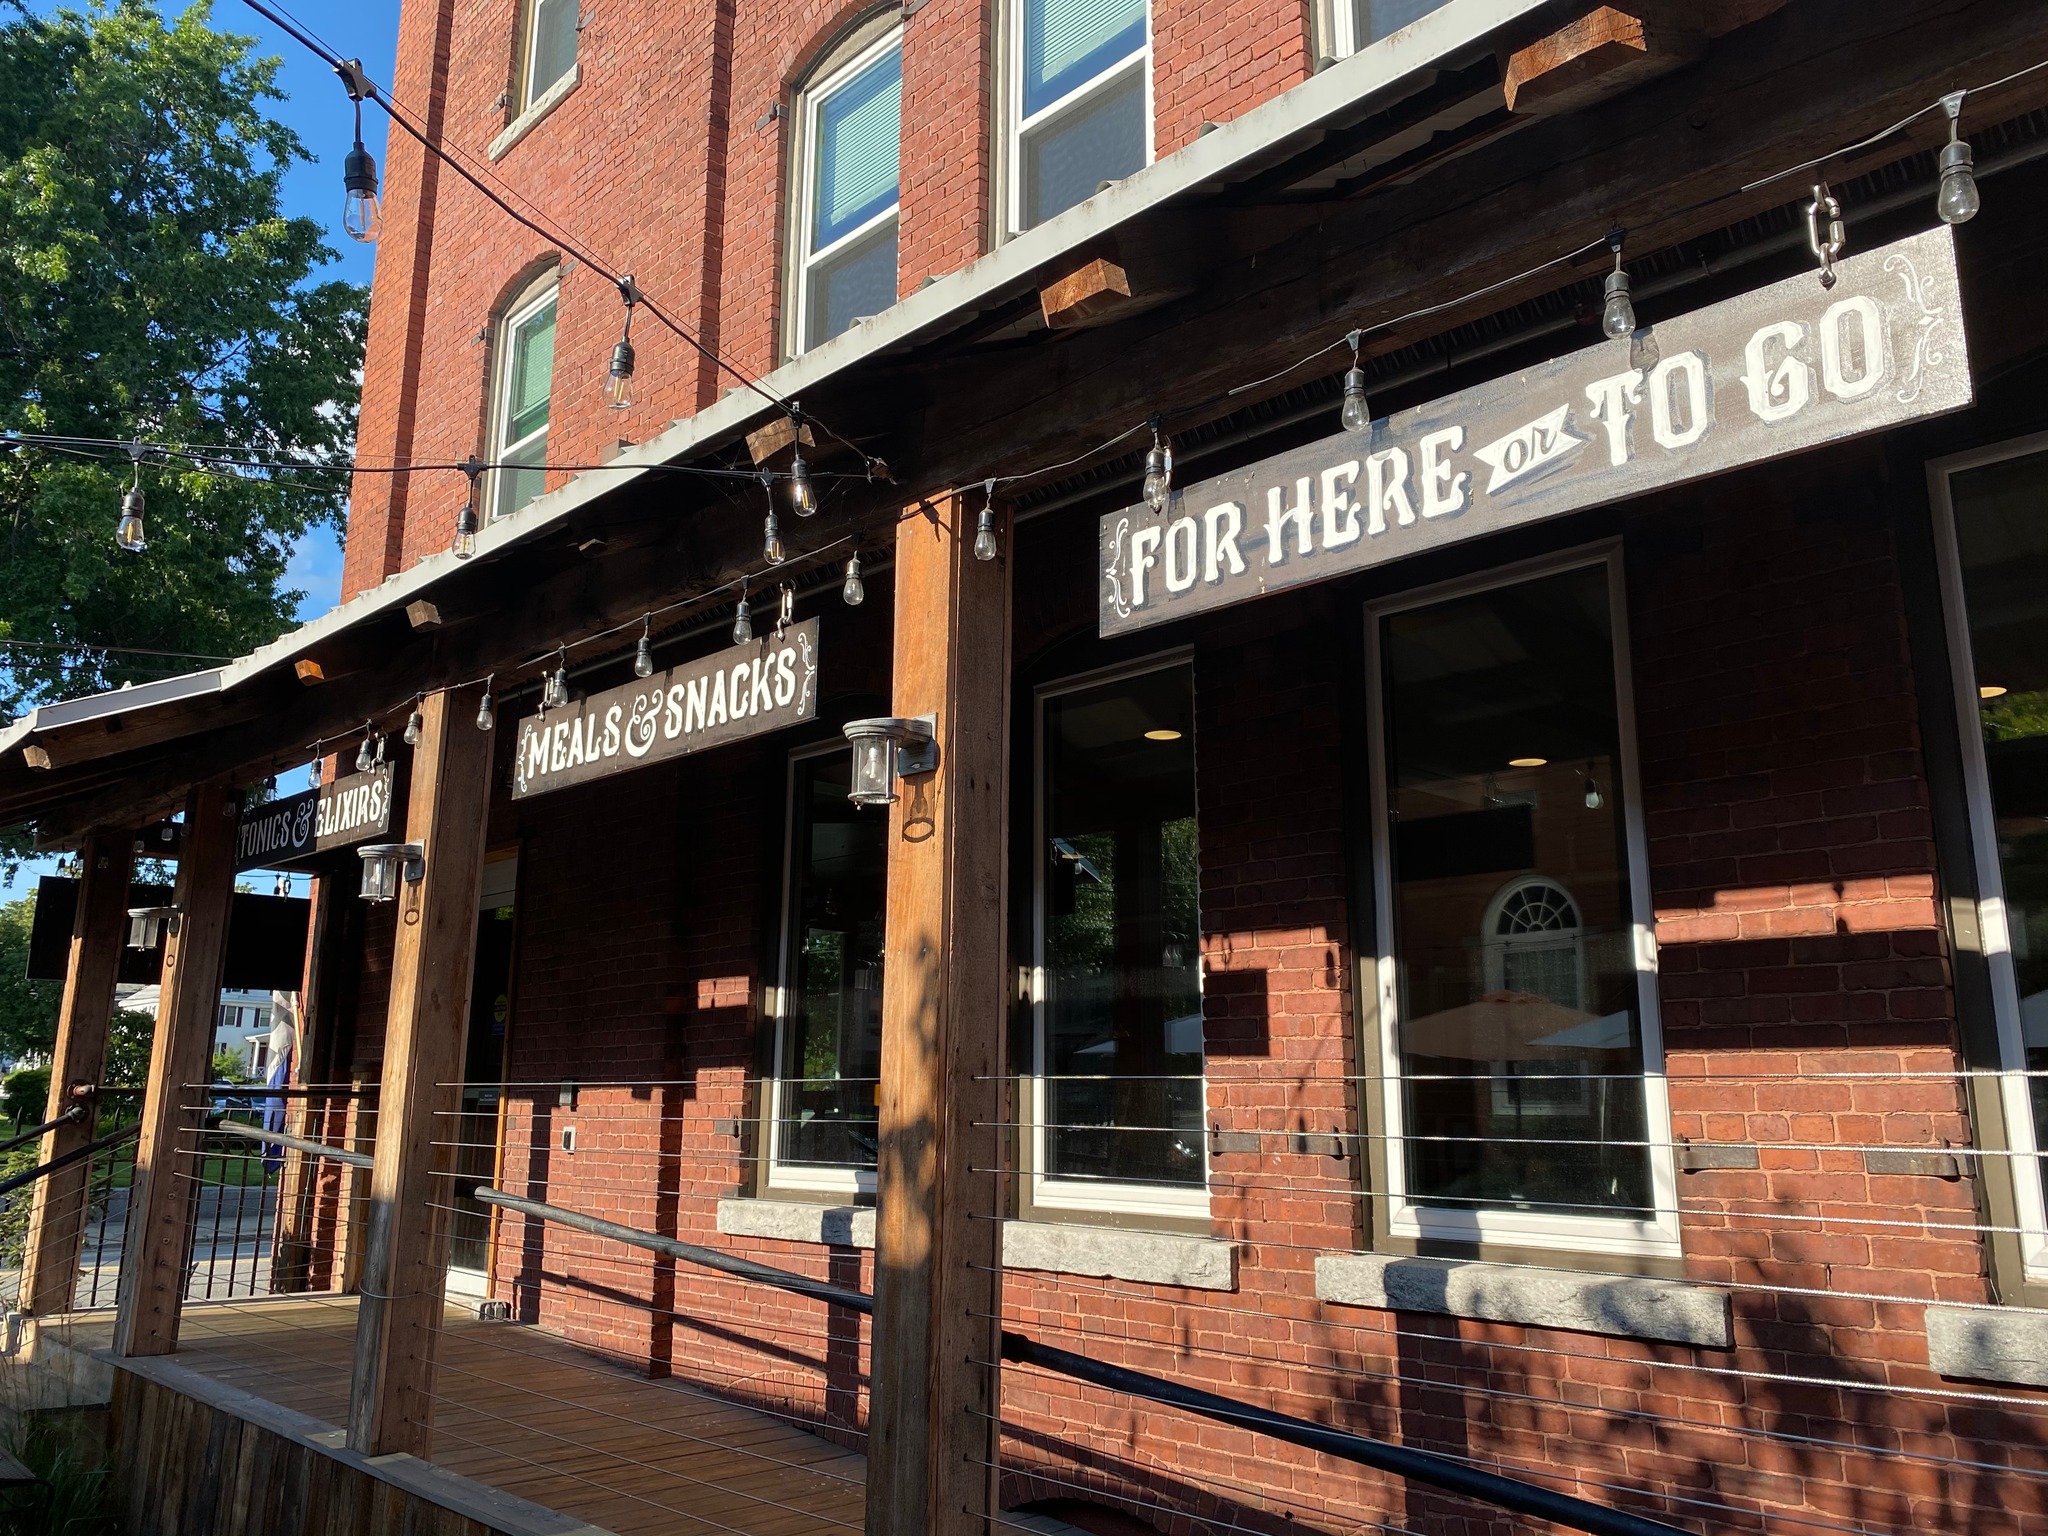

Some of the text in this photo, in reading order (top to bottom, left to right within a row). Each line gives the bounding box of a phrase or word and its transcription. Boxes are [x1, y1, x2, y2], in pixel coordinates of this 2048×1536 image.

[1129, 501, 1246, 606] FOR
[1263, 425, 1467, 564] HERE
[1586, 351, 1708, 467] TO
[1740, 295, 1885, 423] GO
[527, 647, 797, 779] MEALS & SNACKS
[240, 779, 383, 859] TONICS & ELIXIRS
